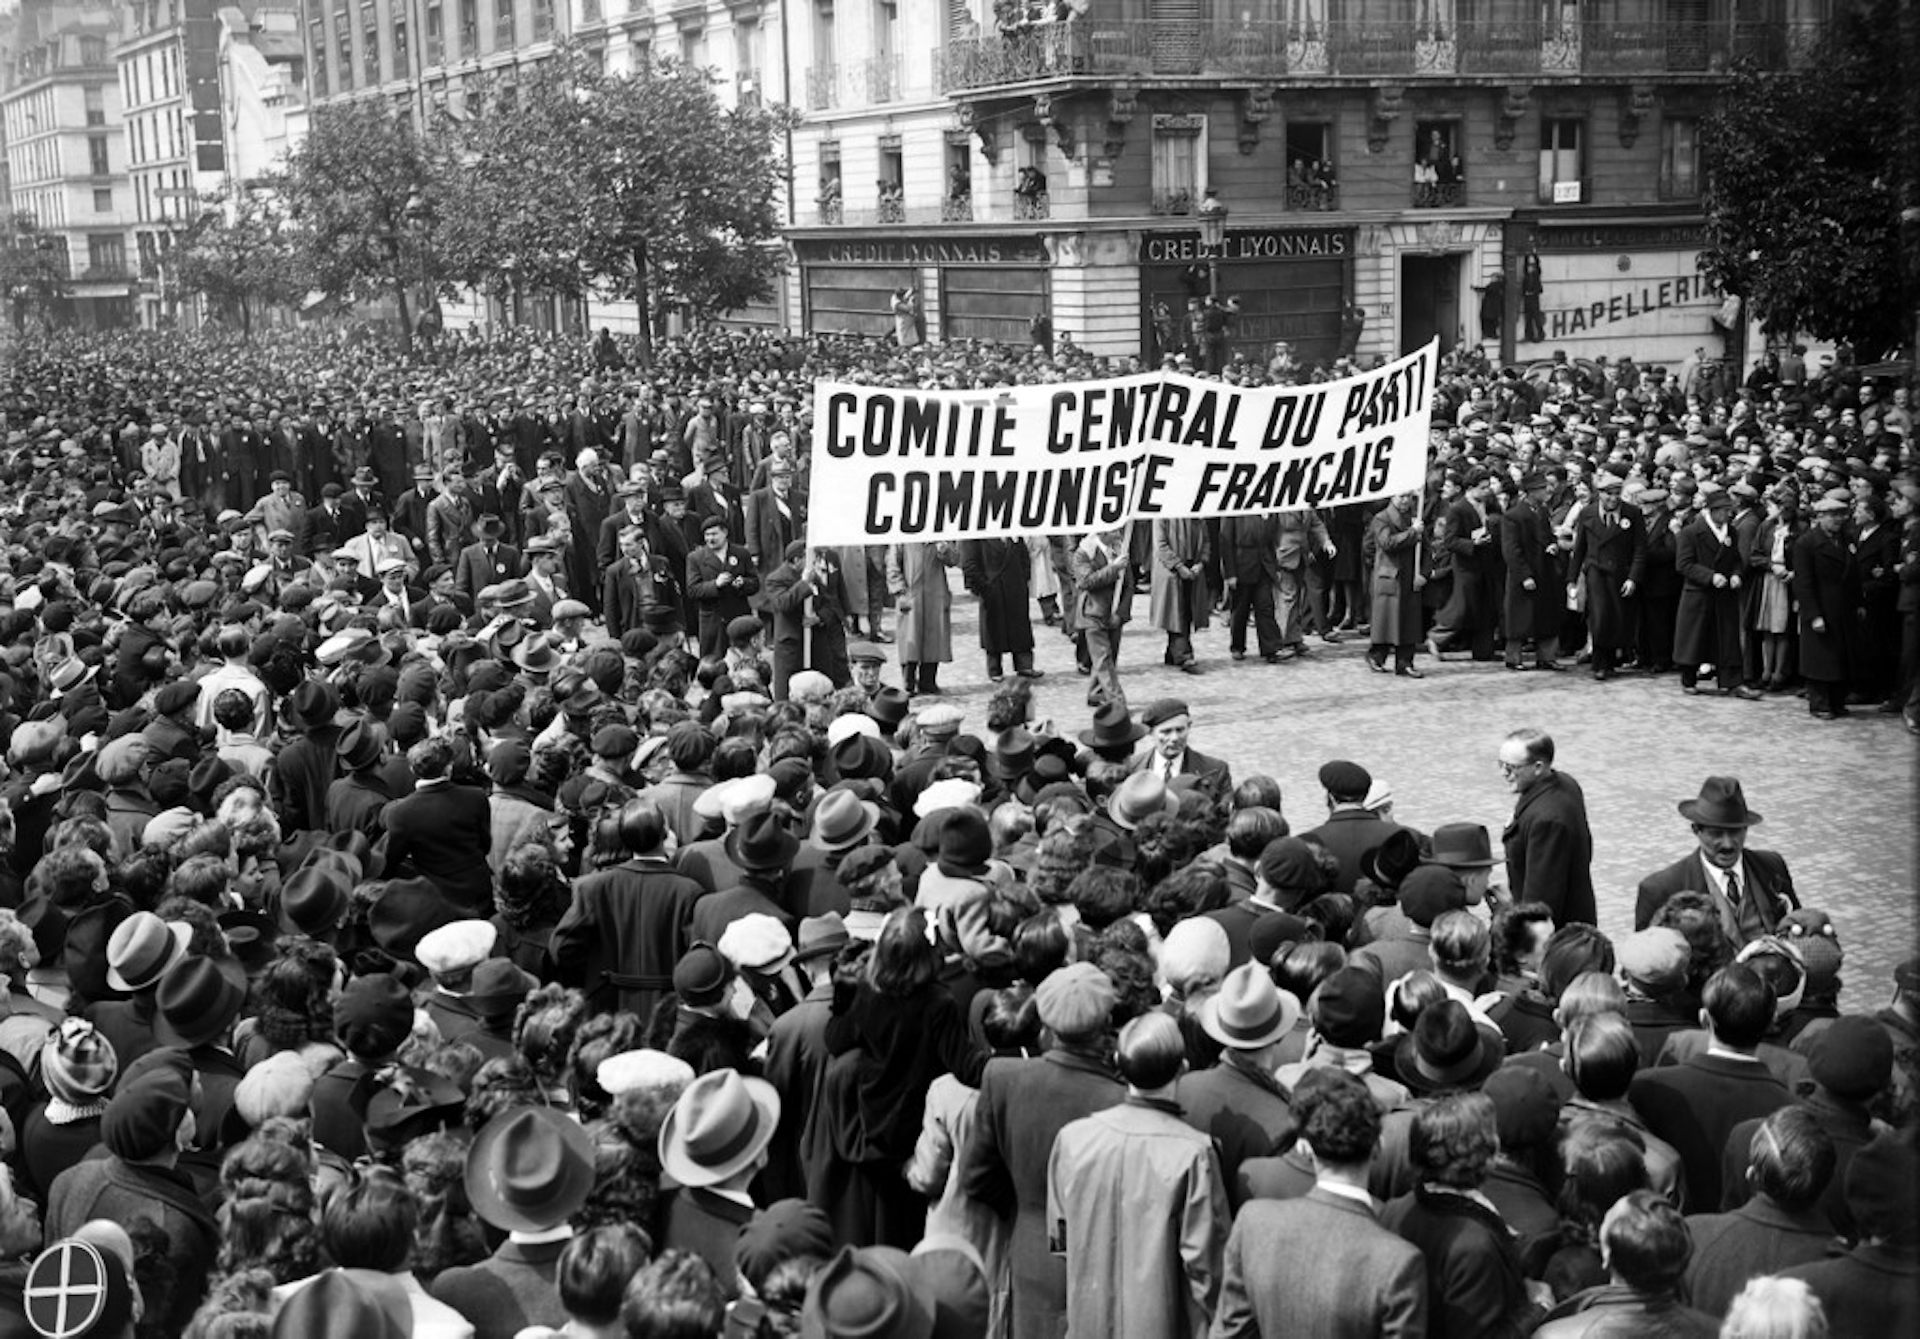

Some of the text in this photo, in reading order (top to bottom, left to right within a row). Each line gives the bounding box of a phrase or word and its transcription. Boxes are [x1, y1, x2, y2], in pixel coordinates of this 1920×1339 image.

[829, 243, 1000, 263] CREDIT LYONNAIS
[1148, 234, 1344, 260] CREDT LYONNAIS
[1551, 273, 1714, 339] HAPELLERI
[1047, 381, 1241, 454] CENTRAL
[1260, 391, 1327, 450] DU
[1337, 352, 1426, 439] PARTI
[864, 435, 1394, 535] COMMUNISTE FRANÇAIS
